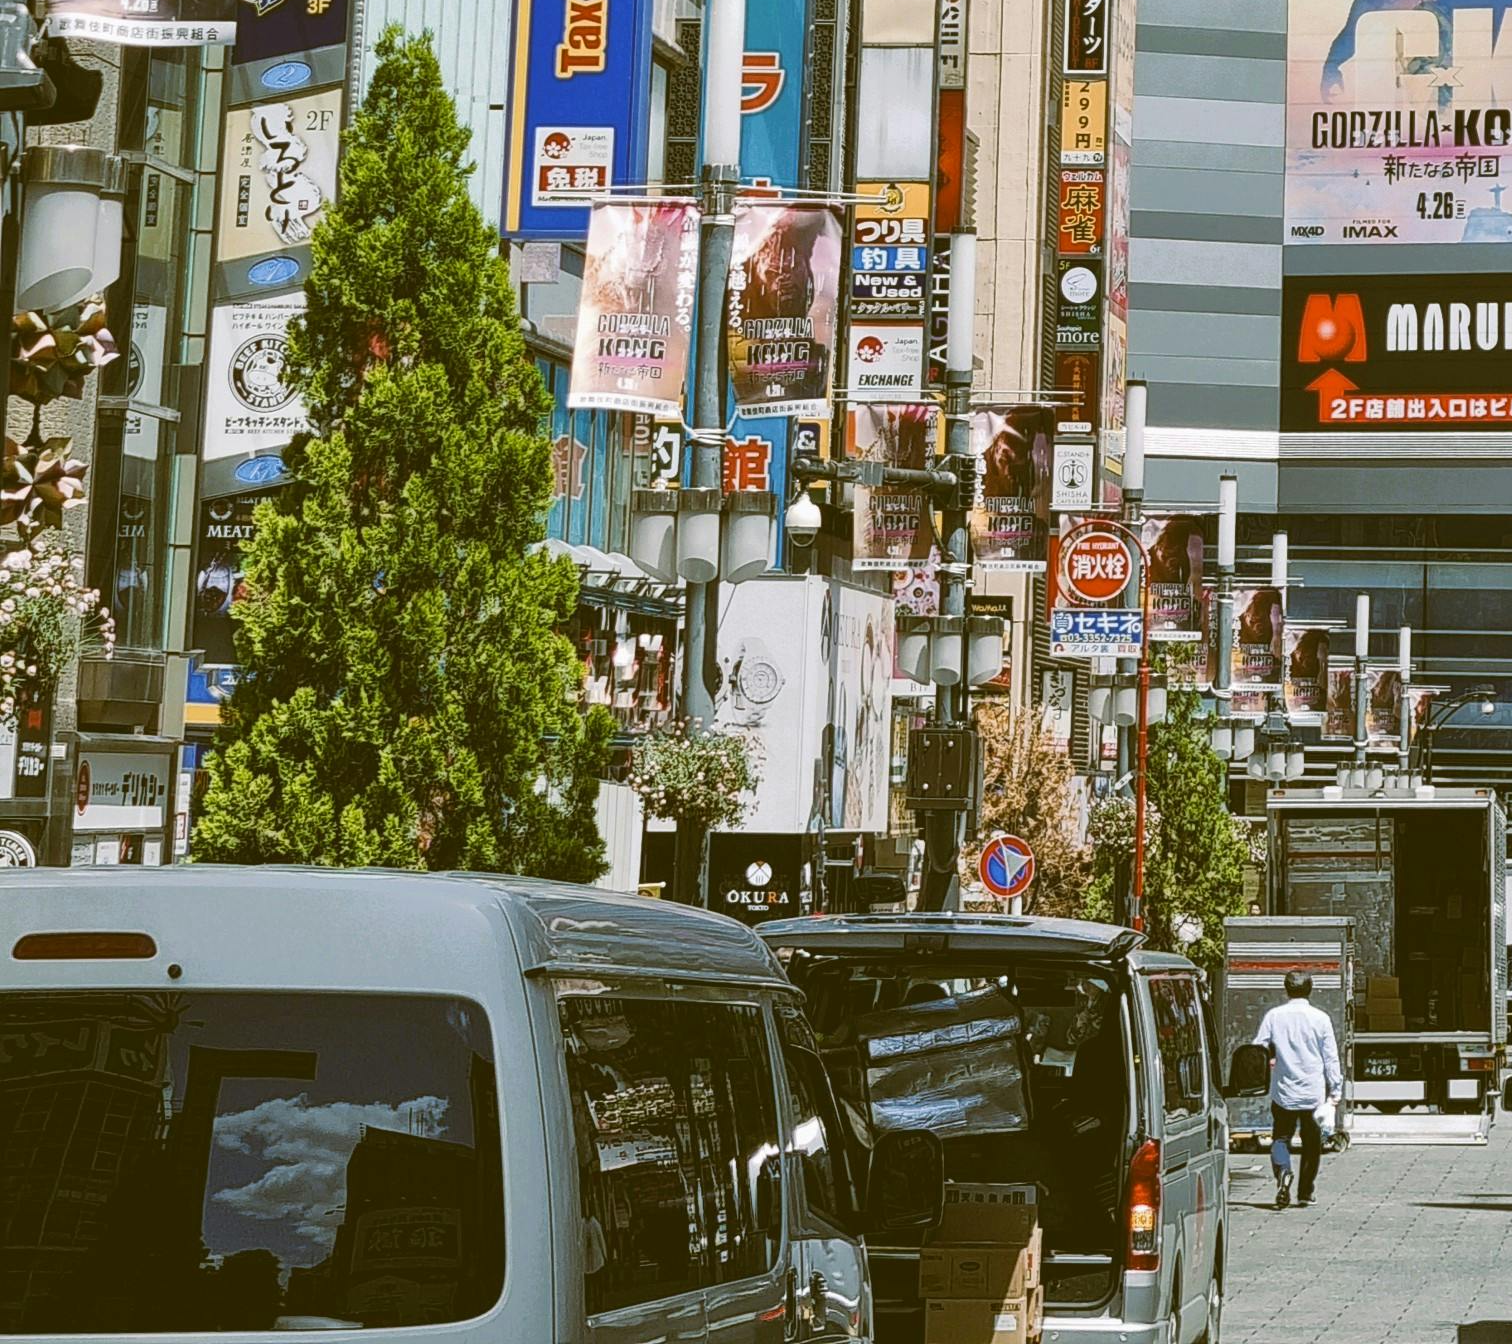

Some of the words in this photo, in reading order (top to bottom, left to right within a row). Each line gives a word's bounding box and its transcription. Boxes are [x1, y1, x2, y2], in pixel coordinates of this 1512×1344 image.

[306, 110, 334, 132] 2F
[1075, 82, 1091, 149] 299円
[1311, 109, 1441, 149] GODZILLA
[546, 167, 599, 190] 免税
[1382, 153, 1500, 185] 新たなる帝国
[1061, 184, 1101, 244] 麻雀
[857, 218, 926, 244] つり具
[1291, 225, 1325, 238] MX4D
[1343, 226, 1398, 239] IMAX
[862, 248, 921, 270] 釣具
[855, 274, 899, 286] New
[903, 275, 917, 286] &
[872, 286, 923, 298] Used
[1056, 330, 1100, 344] more
[234, 342, 258, 371] BEEF
[858, 374, 915, 387] EXCHANGE
[246, 390, 286, 409] STAND
[207, 525, 253, 539] MEAT
[1072, 553, 1126, 580] 消火栓
[1067, 634, 1133, 643] 03-3352-7325
